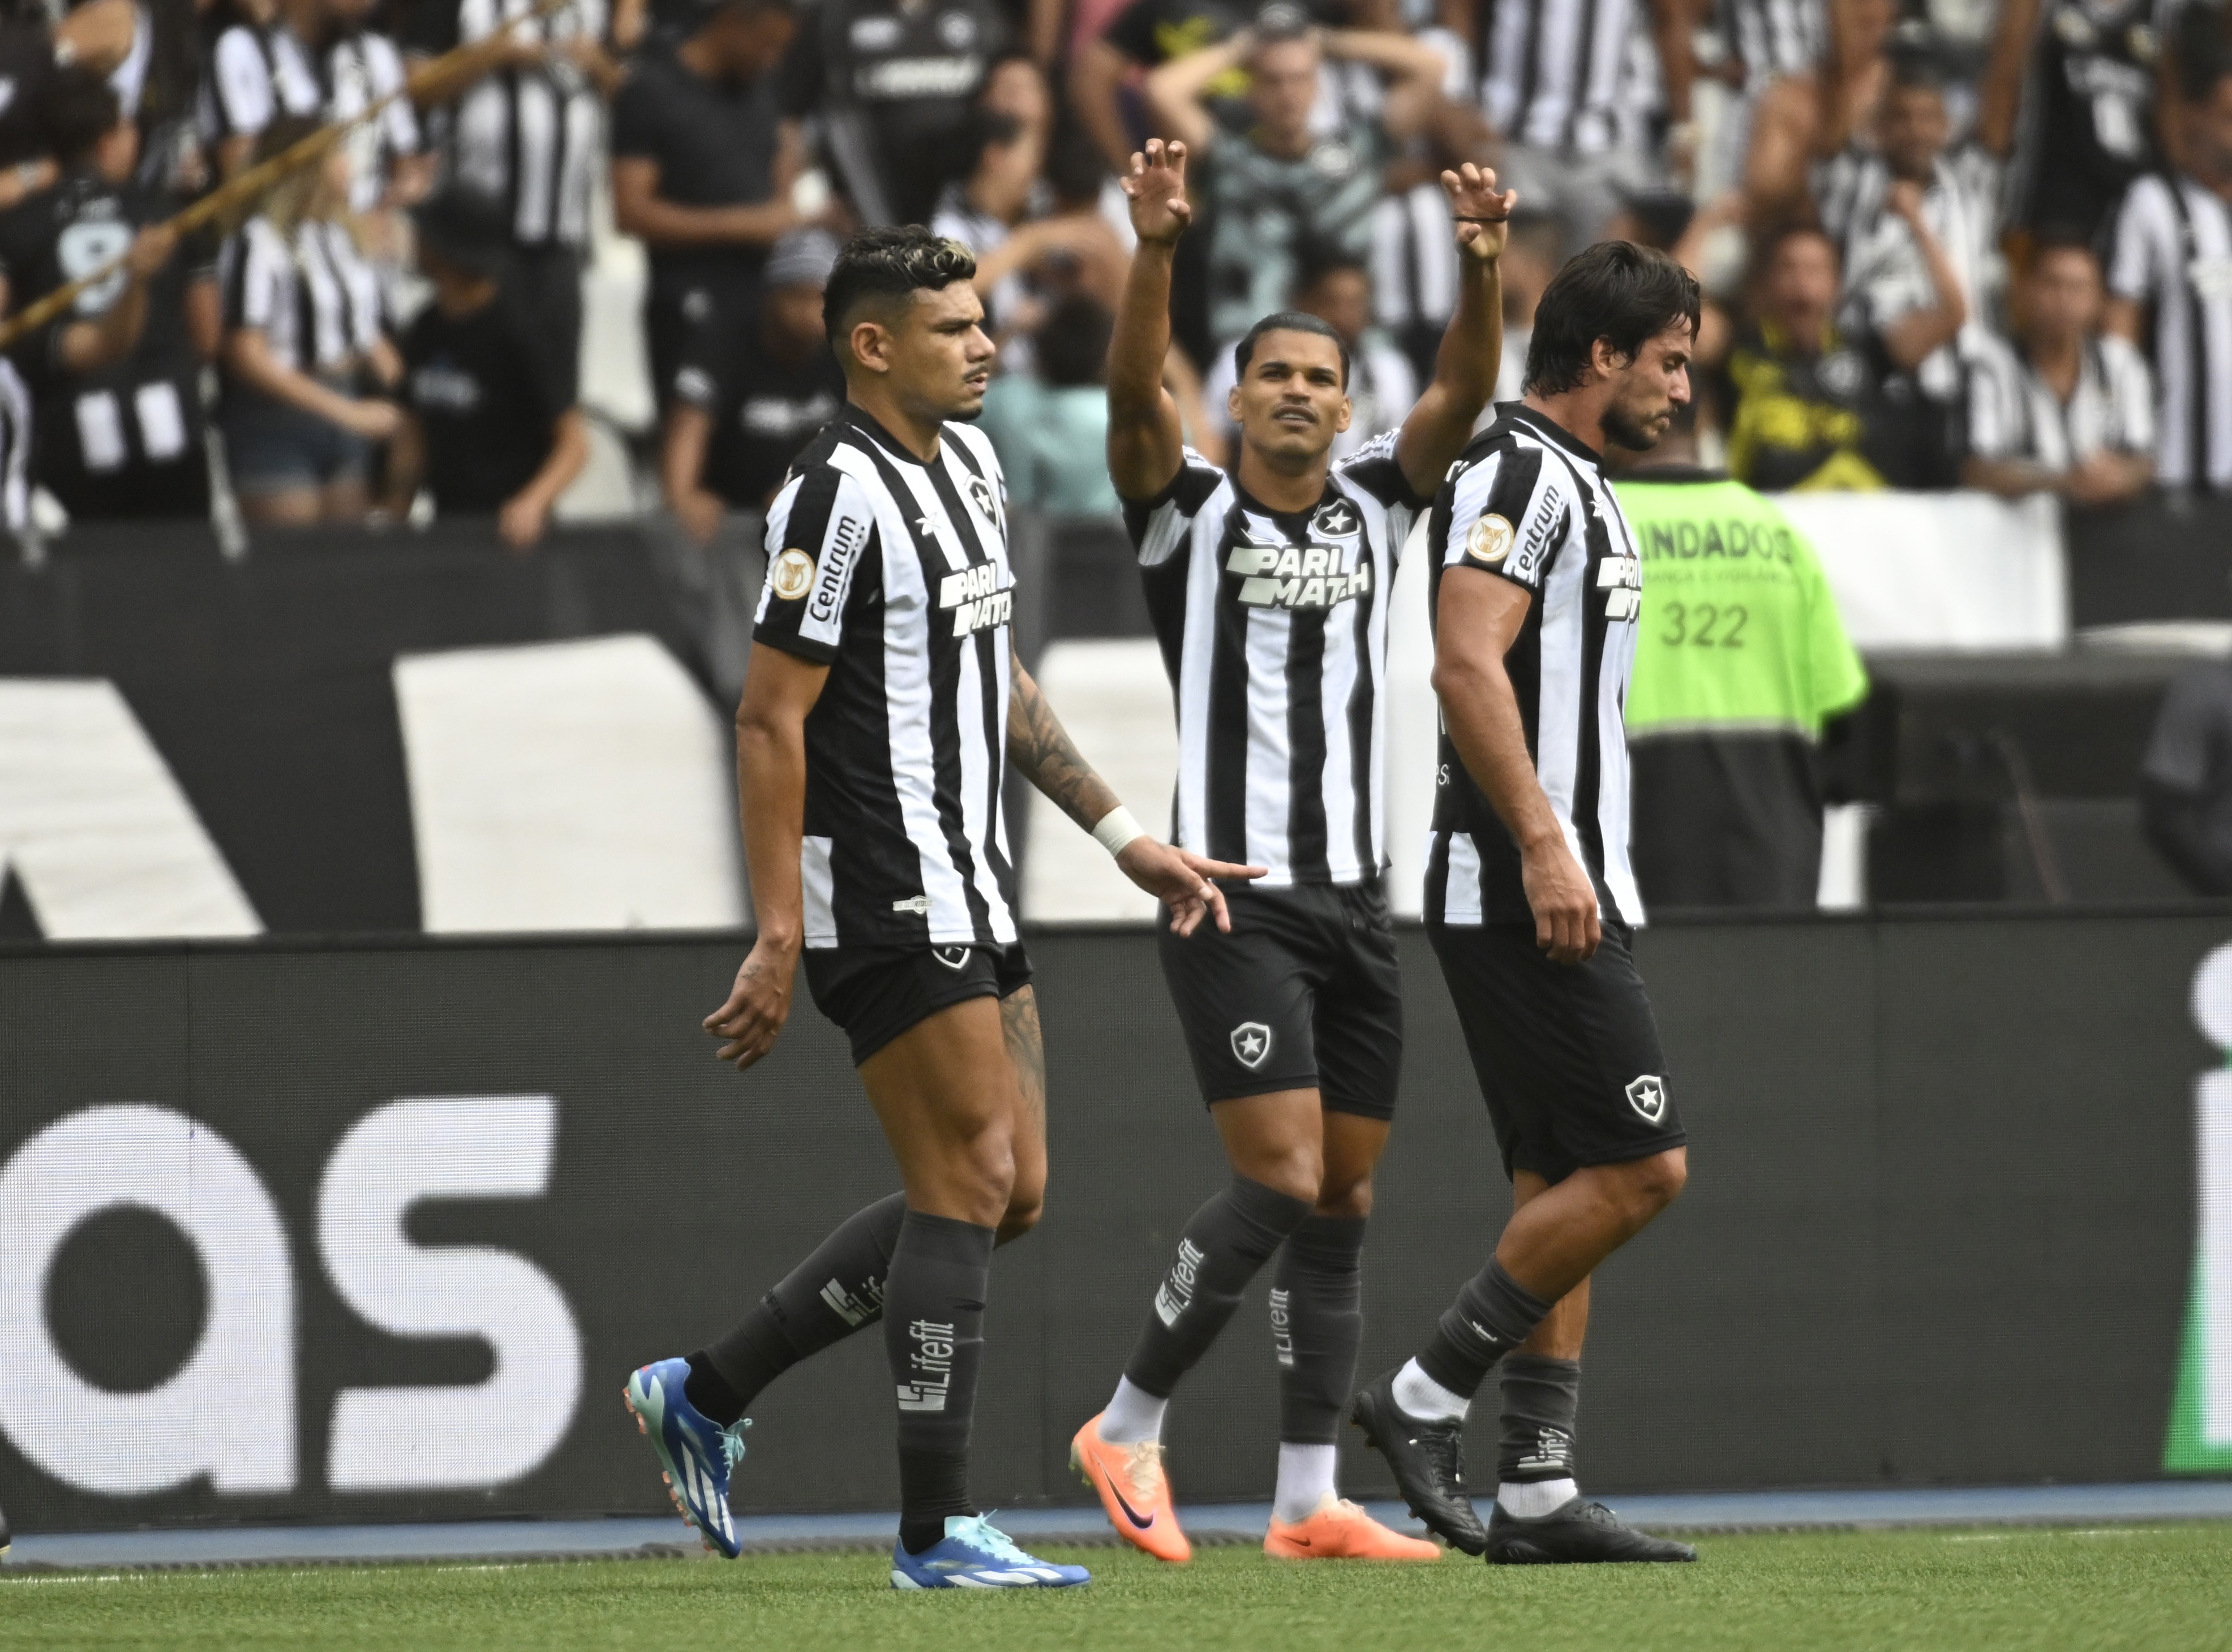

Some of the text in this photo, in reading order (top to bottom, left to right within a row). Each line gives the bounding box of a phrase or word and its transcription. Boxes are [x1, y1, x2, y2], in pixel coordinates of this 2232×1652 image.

[809, 515, 856, 622] Centrum
[939, 562, 997, 608] PARI
[1226, 547, 1340, 576] PARI
[1659, 600, 1748, 648] 322
[909, 1319, 954, 1388] Lifefit
